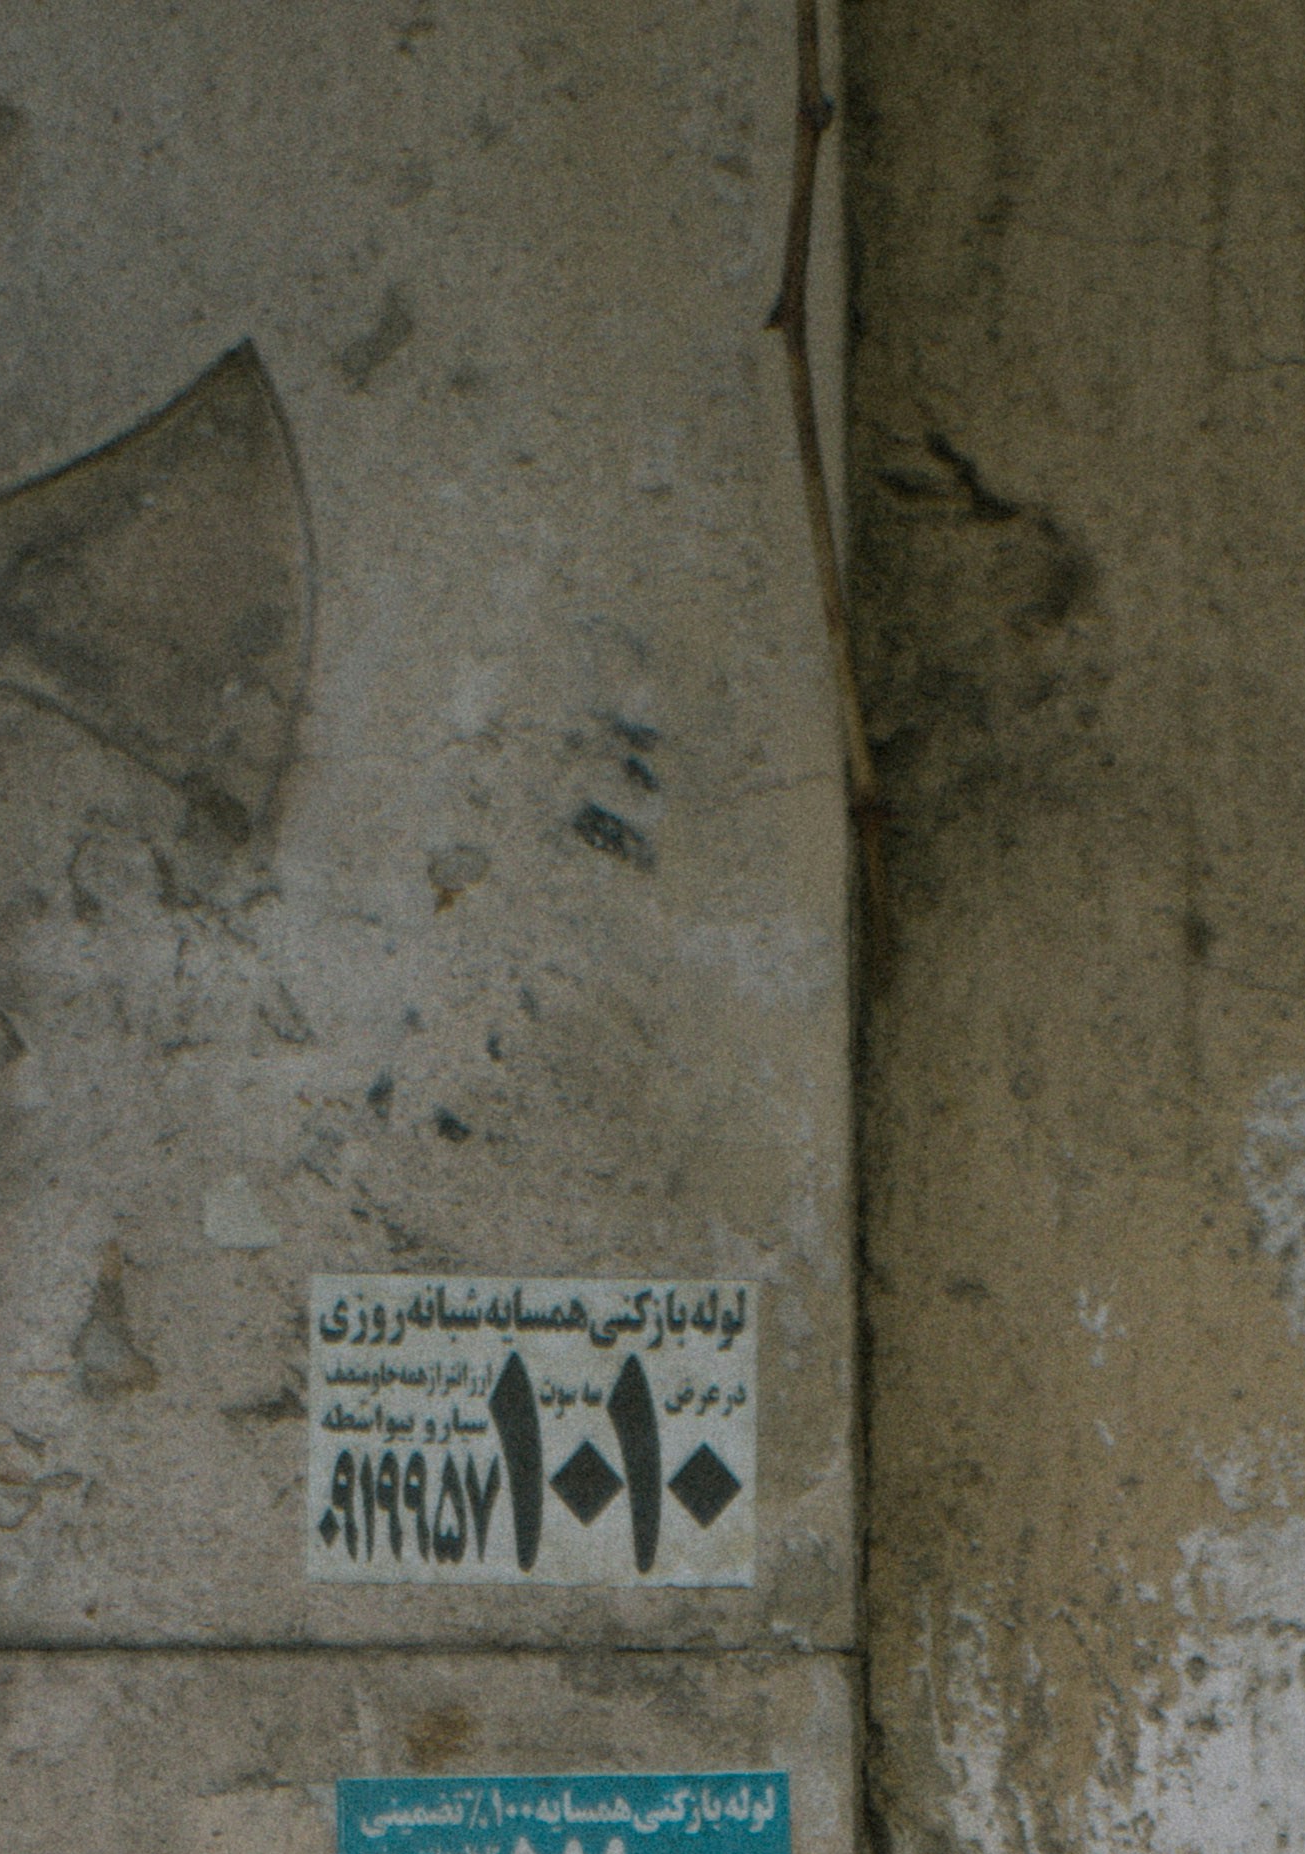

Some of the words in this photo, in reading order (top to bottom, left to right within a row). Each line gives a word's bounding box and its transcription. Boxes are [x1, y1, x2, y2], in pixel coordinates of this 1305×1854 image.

[319, 1292, 405, 1346] روزی
[408, 1285, 482, 1343] شبانه
[487, 1286, 589, 1343] همسایه
[590, 1288, 687, 1350] بازکنی
[692, 1288, 746, 1352] لوله
[536, 1790, 632, 1833] همسایه
[633, 1788, 721, 1834] بازکنی
[725, 1786, 776, 1833] لوله
